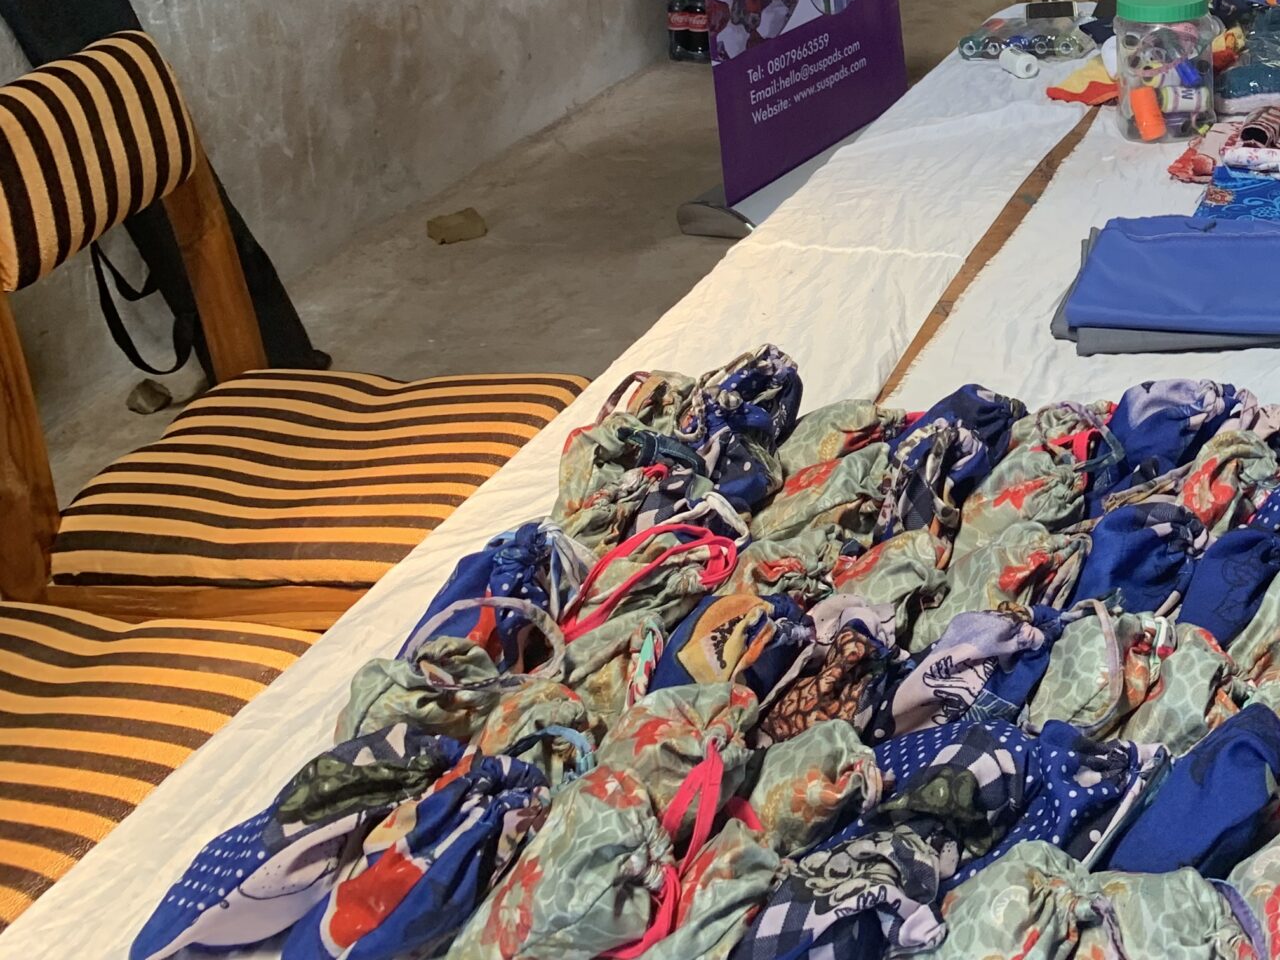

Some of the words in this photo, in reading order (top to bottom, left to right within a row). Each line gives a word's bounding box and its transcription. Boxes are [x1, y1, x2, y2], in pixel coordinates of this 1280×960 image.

[747, 63, 765, 84] Tel:
[767, 33, 830, 75] 08079663559
[751, 97, 792, 124] Website:
[793, 56, 867, 103] www.suspads.com
